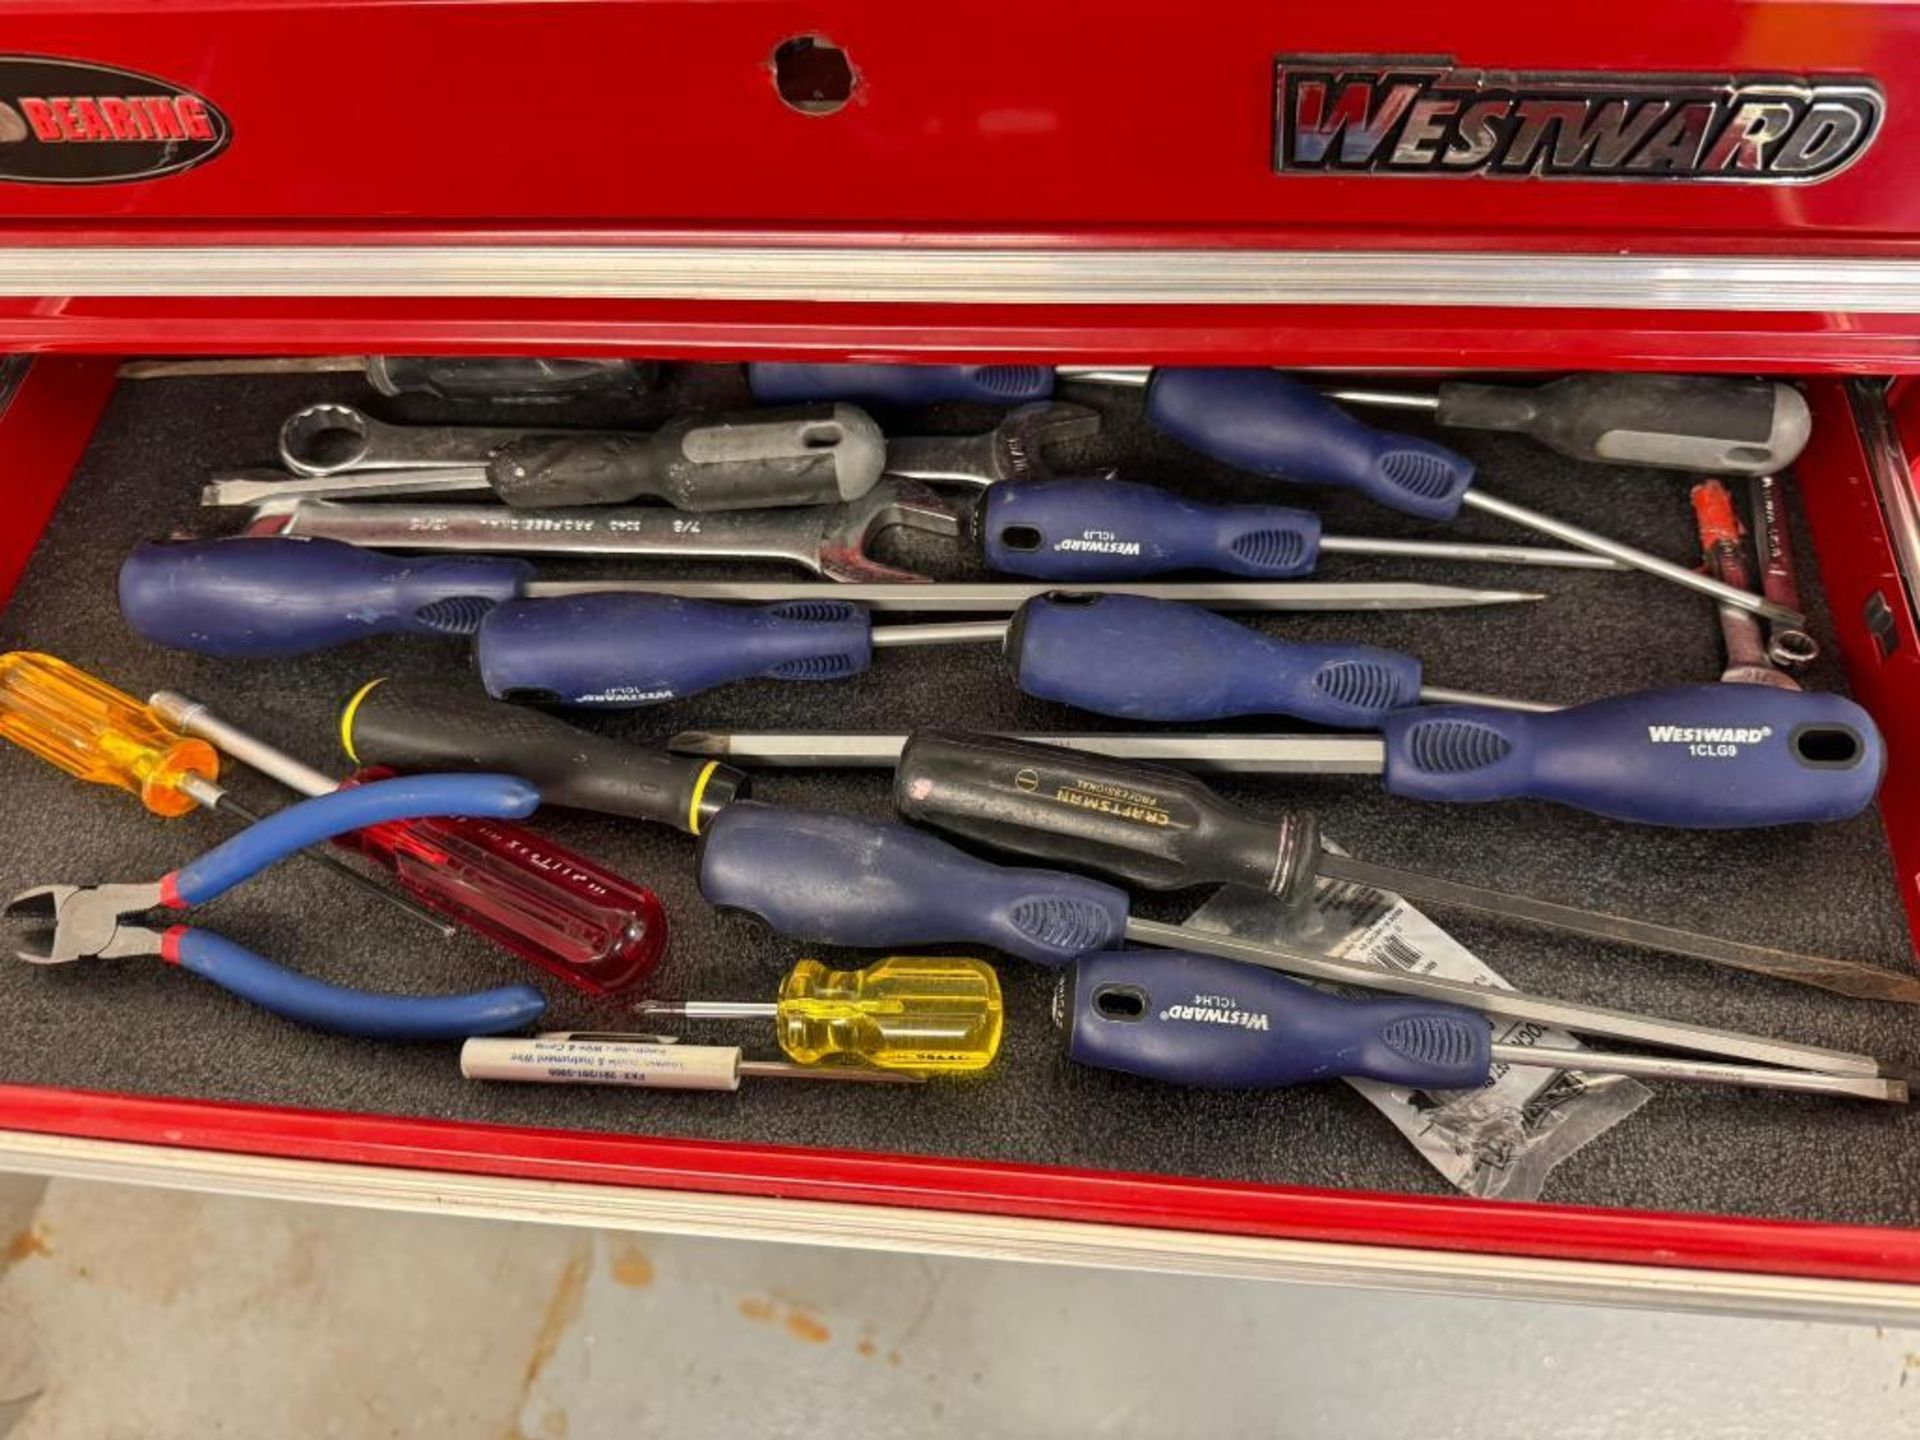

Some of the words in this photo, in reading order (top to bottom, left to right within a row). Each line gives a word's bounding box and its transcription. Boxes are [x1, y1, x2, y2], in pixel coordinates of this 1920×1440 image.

[18, 95, 217, 142] BEARING
[1294, 80, 1862, 171] WESTWARD
[1689, 744, 1737, 757] 1CLG9
[1056, 789, 1169, 825] CRAFTSMAN
[1194, 994, 1238, 1009] 1CLH4
